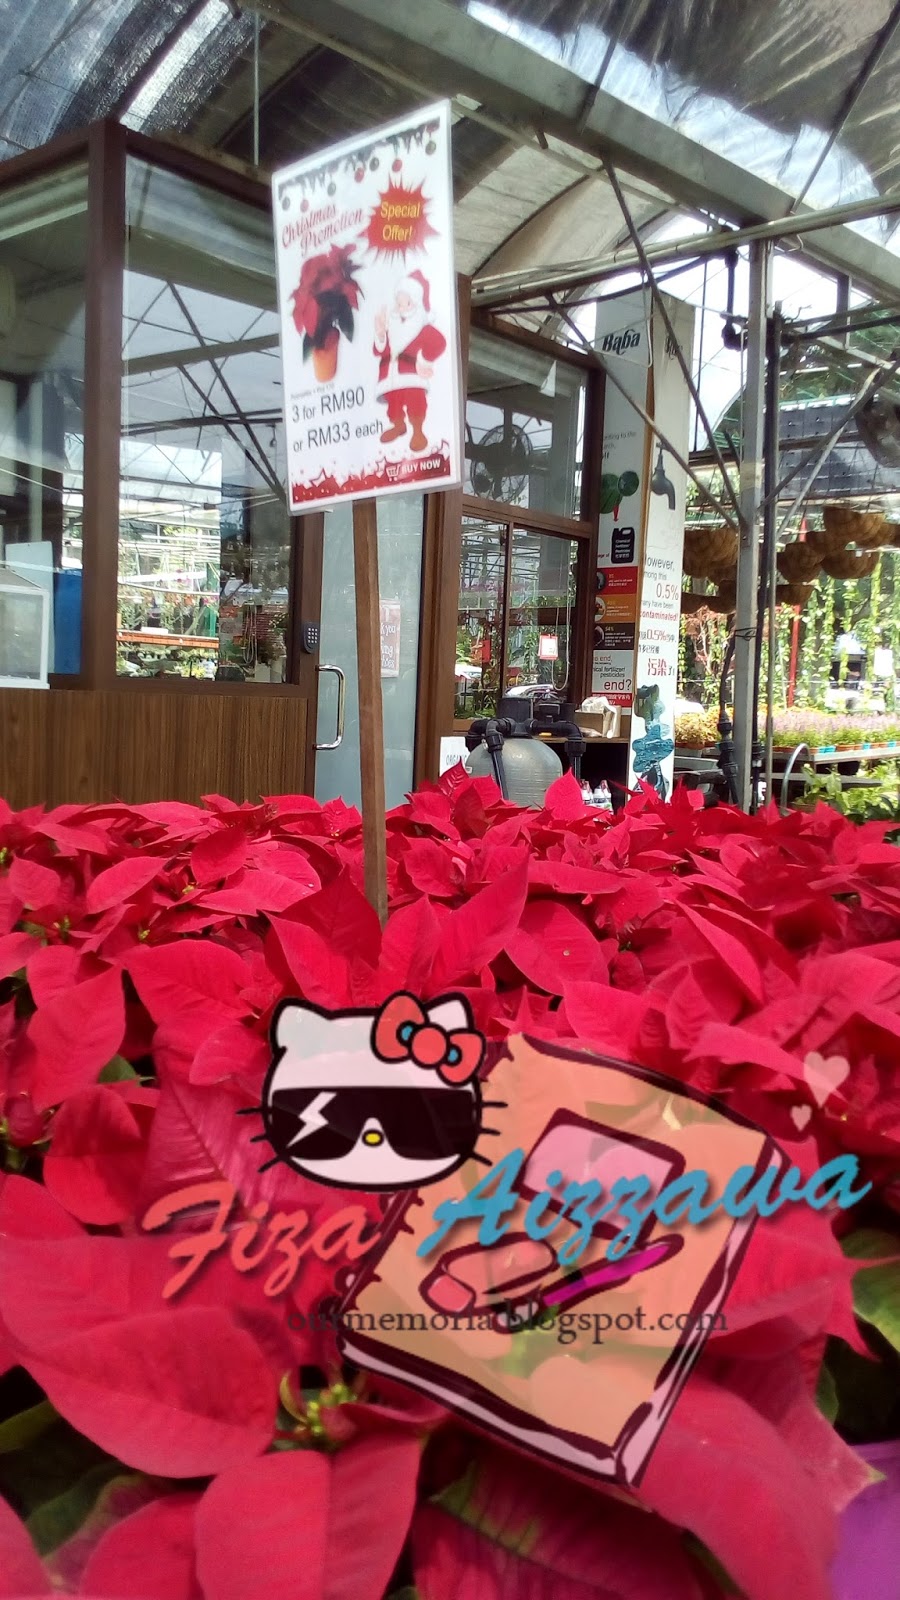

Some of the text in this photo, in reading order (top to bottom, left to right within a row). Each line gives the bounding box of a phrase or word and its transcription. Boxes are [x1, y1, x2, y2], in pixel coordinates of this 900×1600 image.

[380, 200, 421, 221] Special
[281, 204, 337, 248] Christmas
[300, 207, 363, 256] Promotion
[382, 224, 413, 242] Offer!
[602, 329, 641, 355] Baba
[292, 406, 300, 423] 3
[302, 404, 316, 421] for
[320, 386, 365, 417] RM90
[292, 419, 384, 453] or RM33 each
[401, 458, 441, 474] BUY NOW
[645, 556, 675, 572] owever,
[656, 583, 679, 601] 0.5%
[640, 610, 679, 621] ontaminated!
[603, 678, 632, 691] end?
